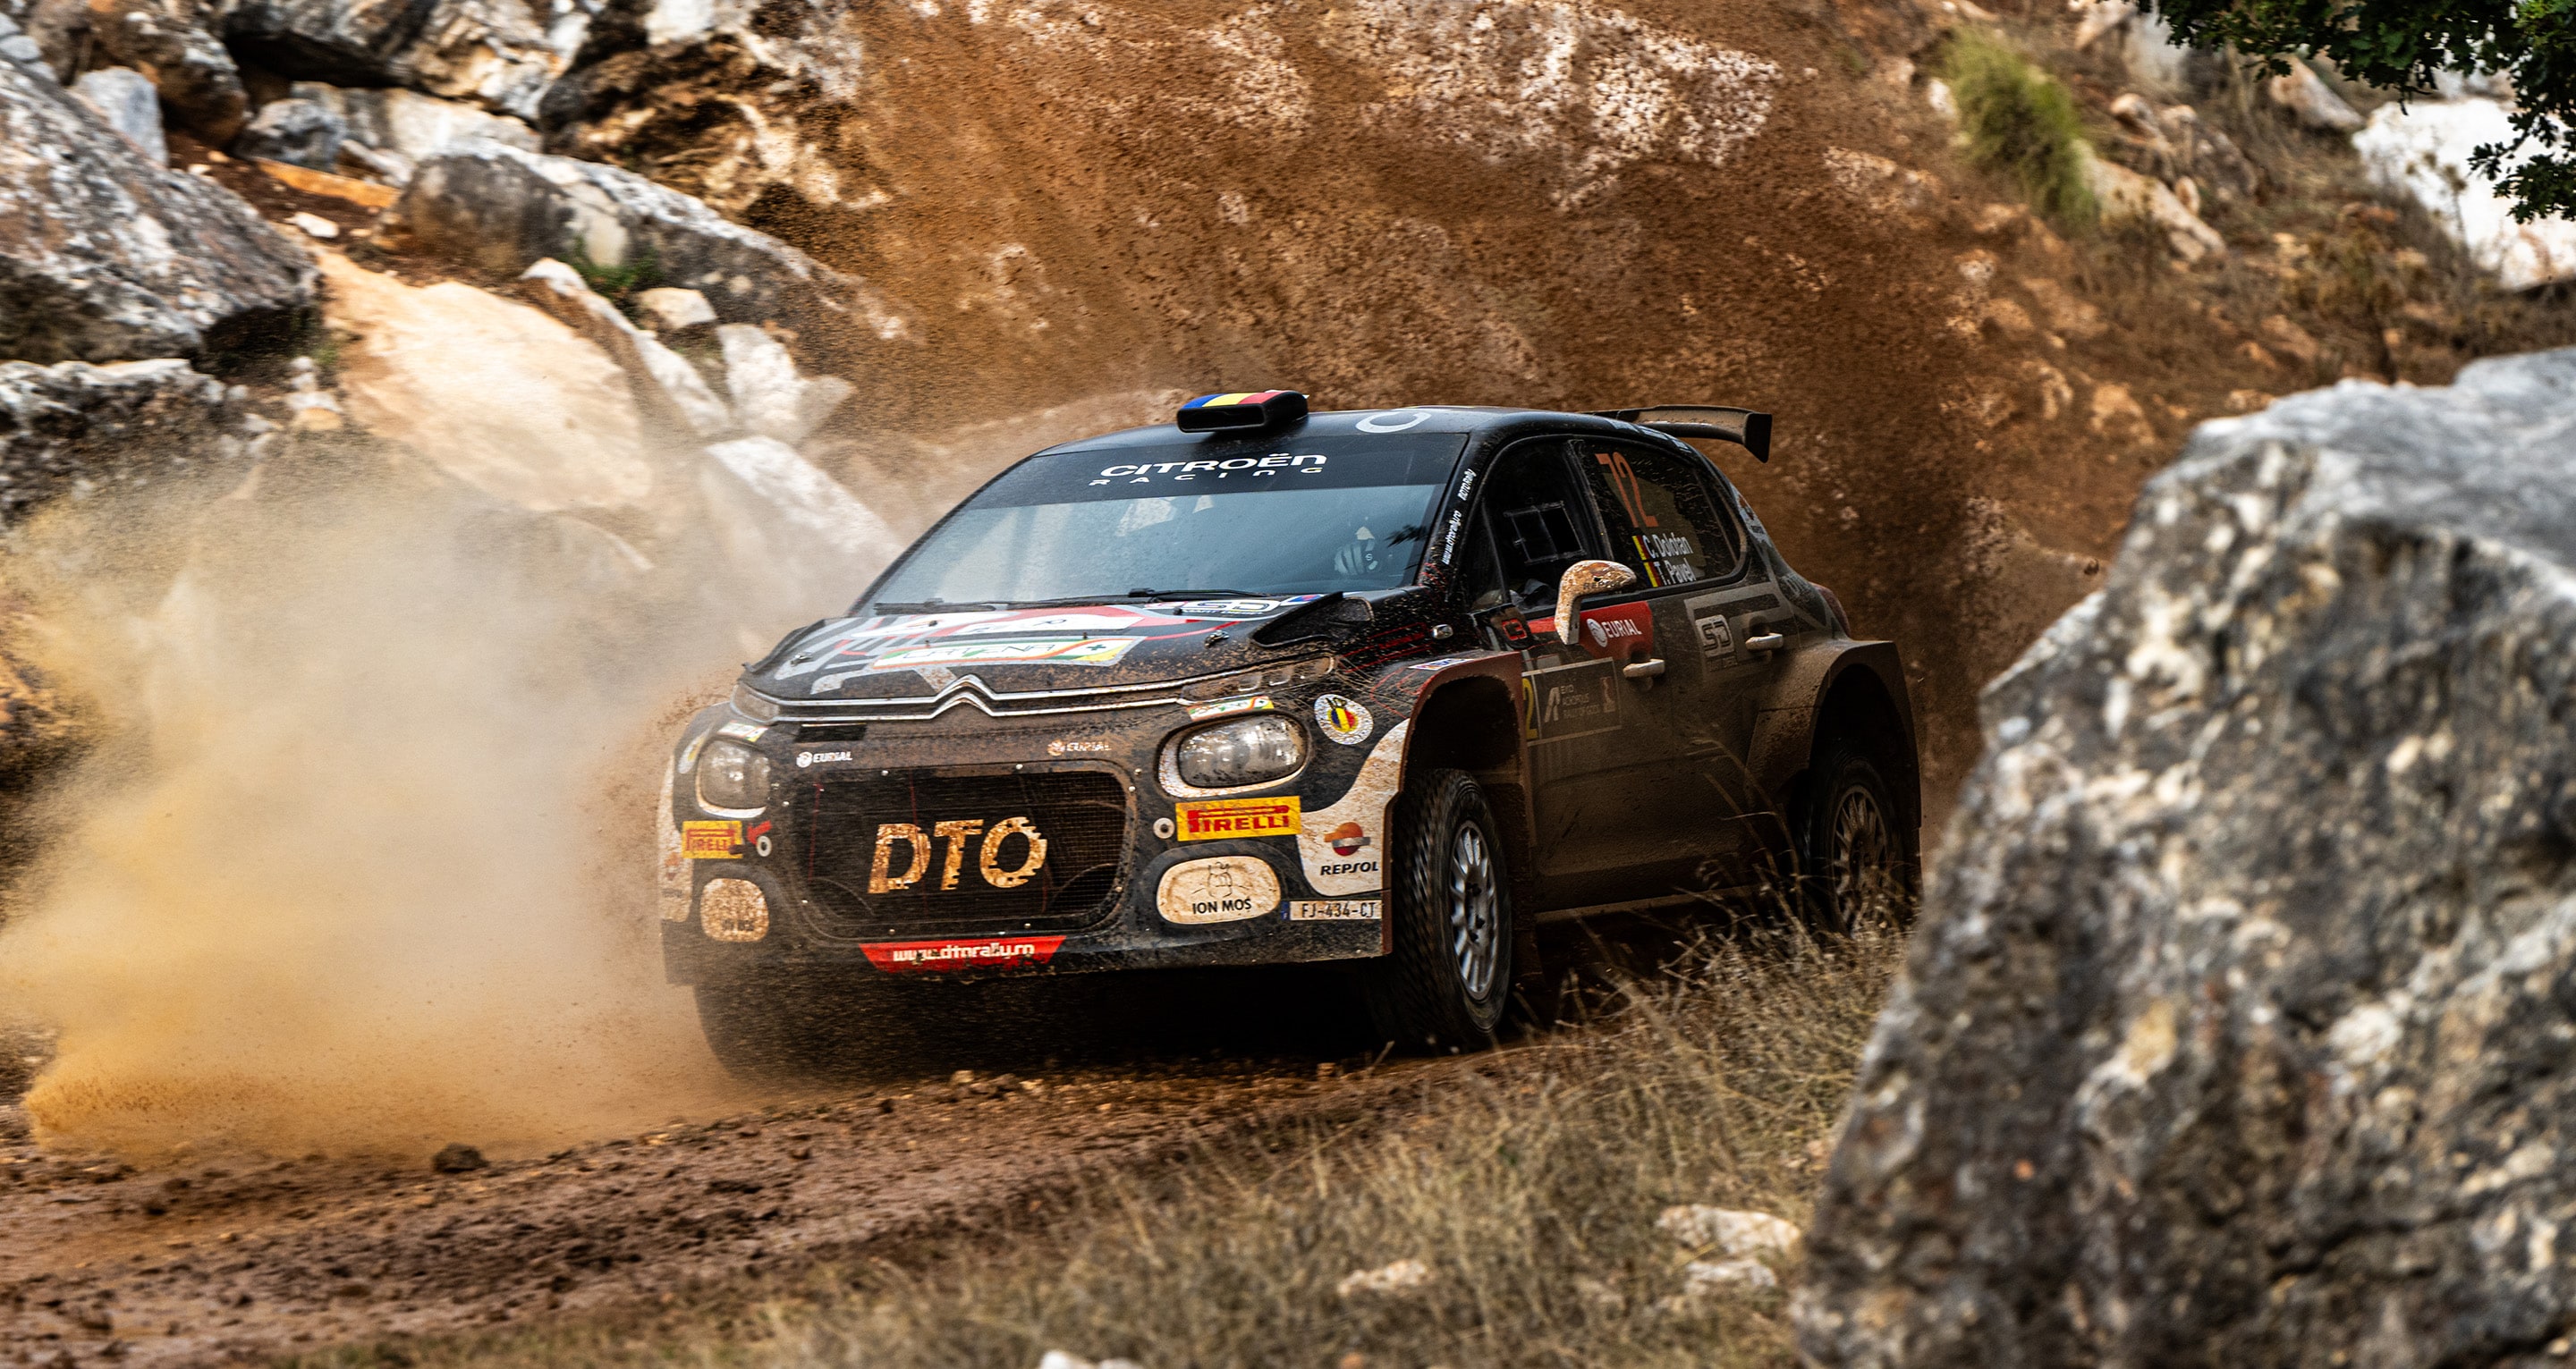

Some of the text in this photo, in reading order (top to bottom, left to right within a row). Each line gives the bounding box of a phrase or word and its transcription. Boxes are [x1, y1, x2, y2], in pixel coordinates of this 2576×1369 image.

[1100, 453, 1327, 477] CITROËN
[1089, 467, 1323, 486] RACING
[1595, 452, 1659, 528] 72
[1642, 535, 1659, 558] C.
[1653, 561, 1671, 586] T.
[1664, 557, 1696, 584] Pavel
[1601, 619, 1642, 638] EURIAL
[812, 751, 853, 763] EURIAL
[1187, 805, 1290, 833] PIRELLI
[868, 816, 1047, 893] DTO
[1319, 861, 1379, 876] REPSOL
[1192, 898, 1252, 915] ION MOS
[893, 942, 1035, 963] www.dtorally.ro
